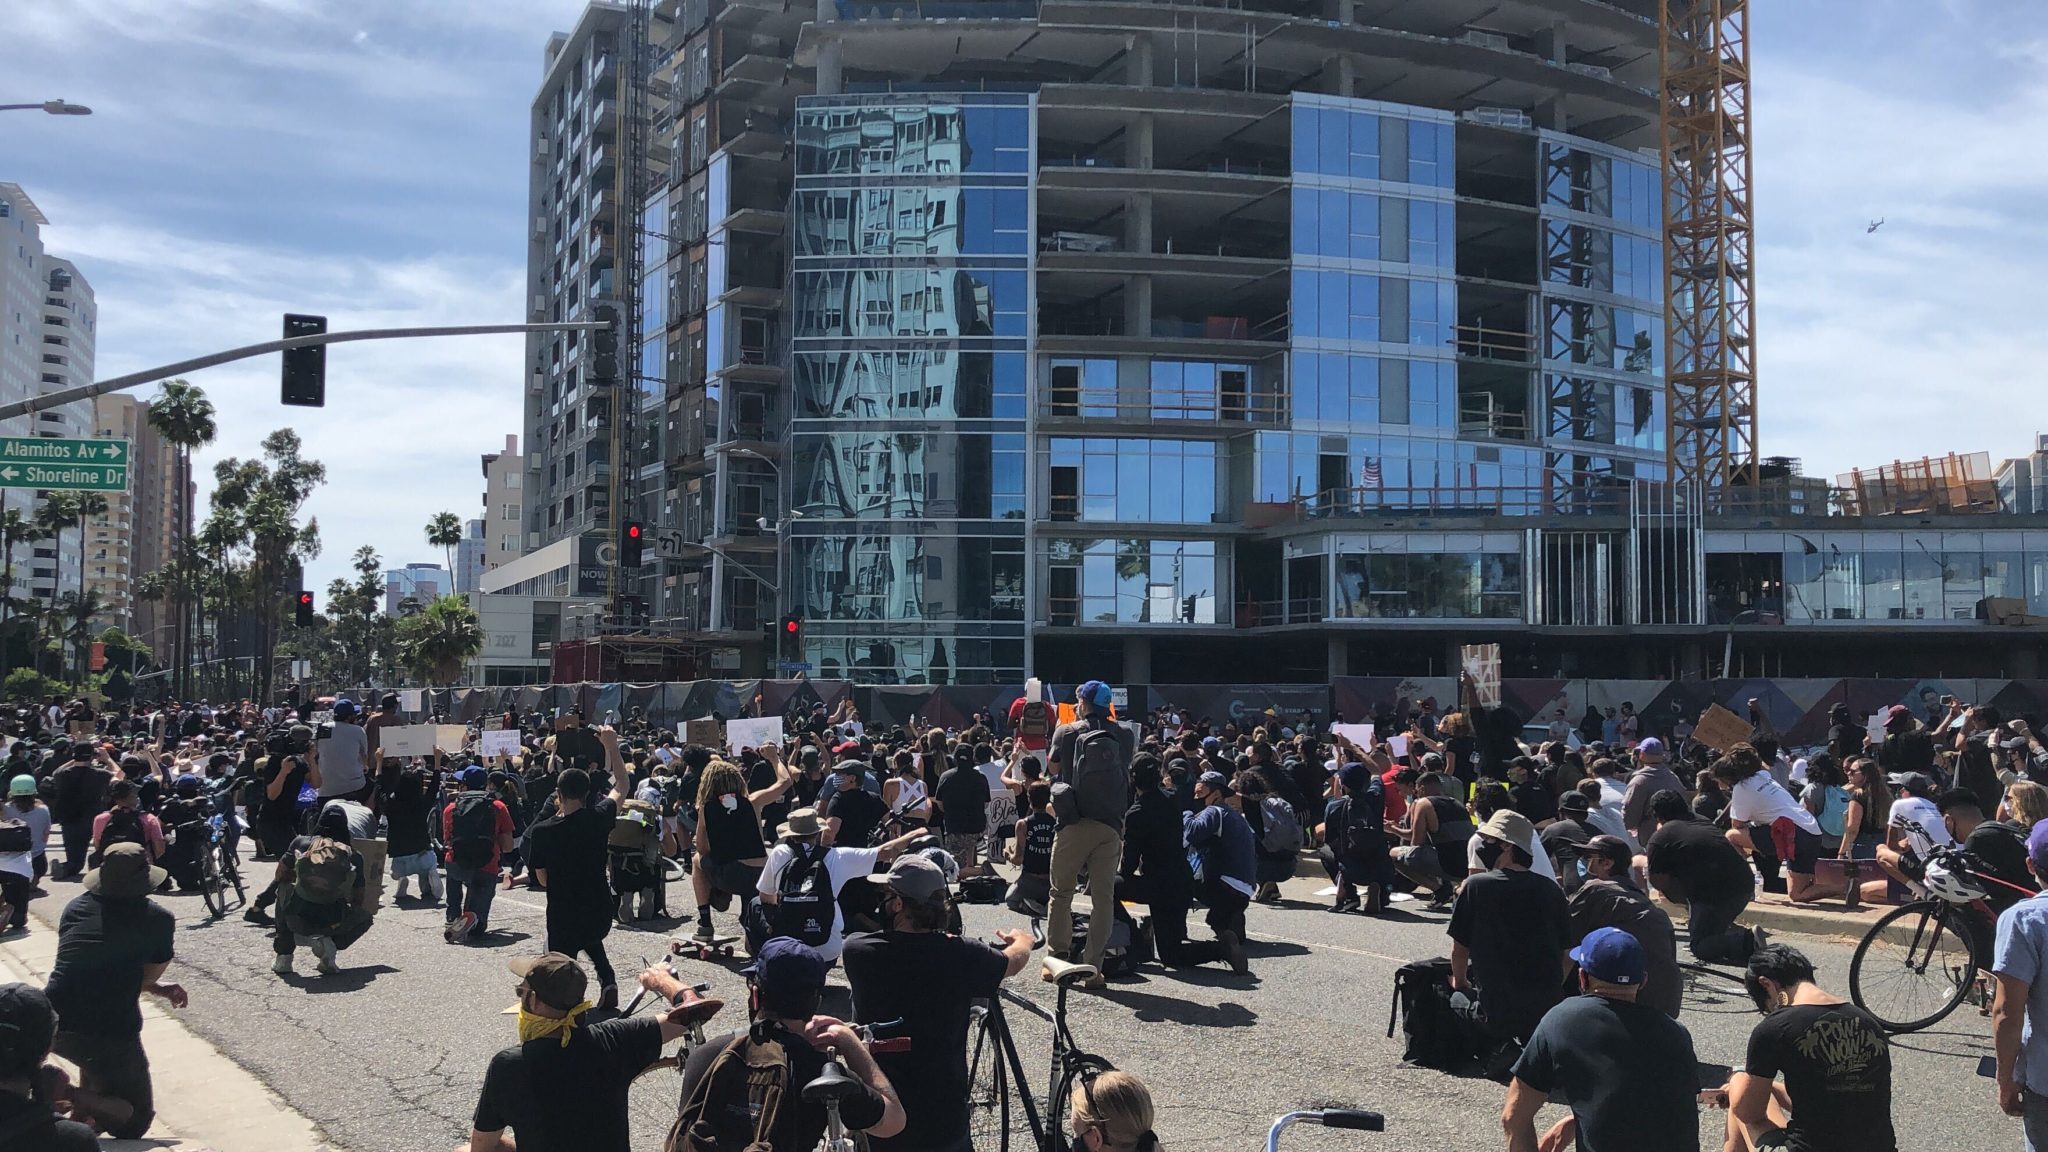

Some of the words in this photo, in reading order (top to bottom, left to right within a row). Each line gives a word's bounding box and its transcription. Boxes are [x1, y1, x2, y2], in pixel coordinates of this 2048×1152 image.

[4, 441, 70, 458] Alamitos
[77, 443, 97, 459] Av
[26, 467, 99, 484] Shoreline
[106, 469, 124, 484] Dr
[581, 570, 608, 579] NOW
[991, 799, 1017, 824] Bla
[1033, 824, 1050, 832] REST
[1028, 844, 1051, 854] WICKE
[1813, 1016, 1860, 1045] POW!
[1819, 1029, 1866, 1065] WOW!
